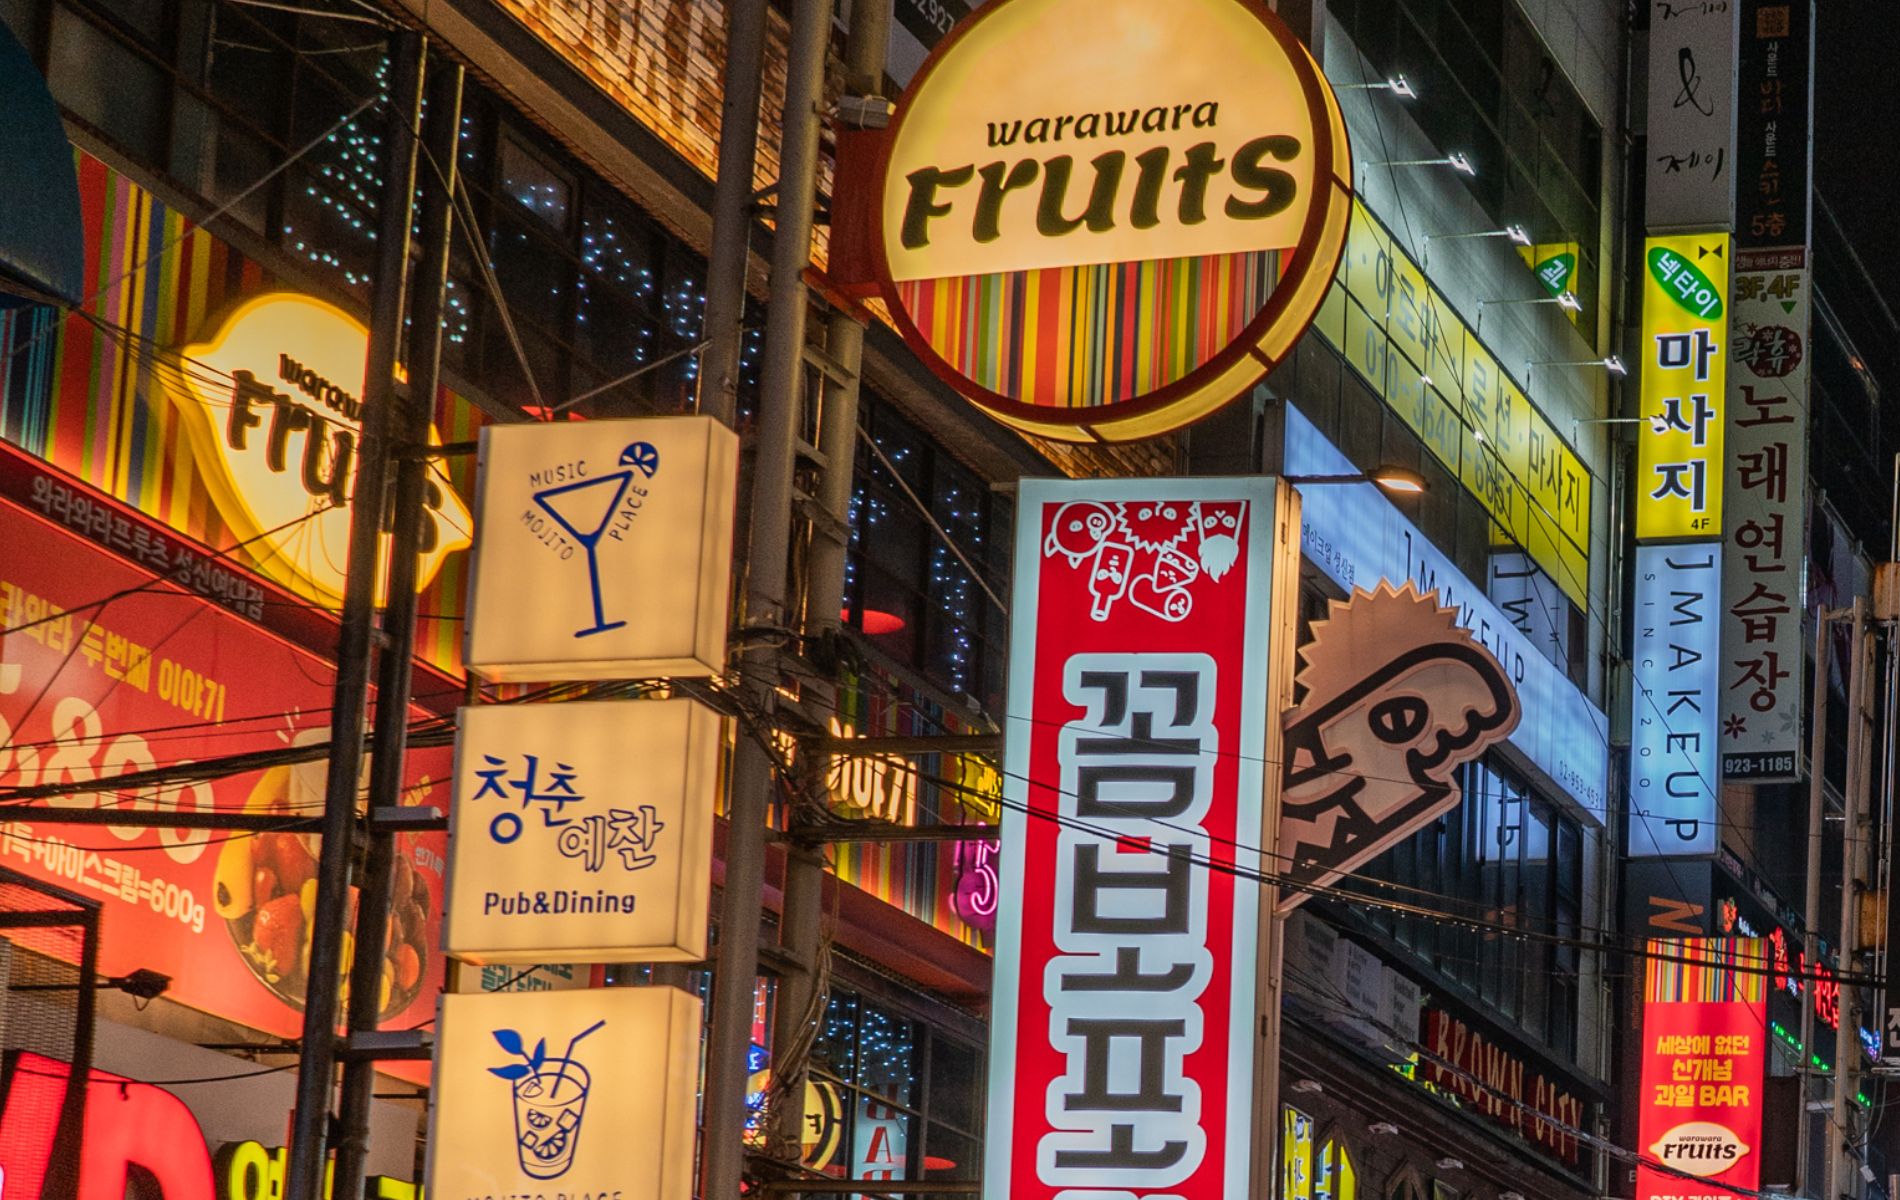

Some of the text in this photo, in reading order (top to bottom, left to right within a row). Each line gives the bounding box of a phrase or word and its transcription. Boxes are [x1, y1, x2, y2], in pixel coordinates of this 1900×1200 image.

[986, 101, 1219, 148] warawara
[1656, 251, 1722, 320] 넥타이
[1652, 328, 1717, 512] 마사지
[530, 460, 589, 487] MUSIC
[1529, 430, 1581, 533] 마사지
[520, 509, 576, 562] MOJITO
[607, 484, 652, 542] PLACE
[1690, 517, 1711, 531] 4F
[1729, 384, 1797, 712] 노래연습장
[157, 657, 226, 727] 이야기
[1725, 756, 1793, 774] 923-1185
[473, 754, 586, 844] 청춘
[558, 805, 665, 873] 예찬
[483, 889, 636, 917] Pub&Dining
[1656, 1035, 1750, 1057] 세상에 없던
[1671, 1059, 1733, 1083] 신개념
[1435, 1009, 1584, 1165] BROWN CITY
[1654, 1085, 1750, 1109] 과일 BAR
